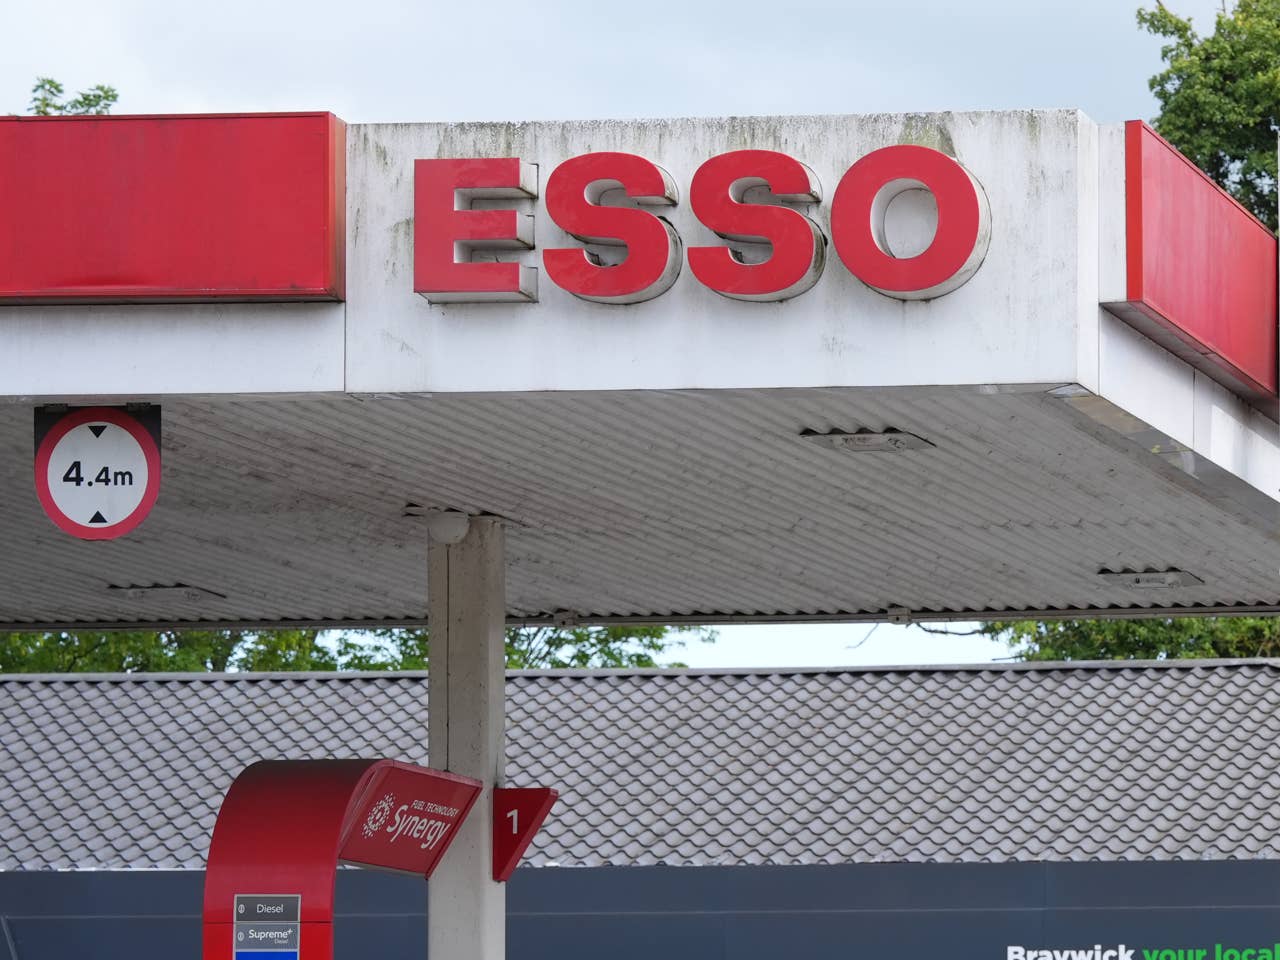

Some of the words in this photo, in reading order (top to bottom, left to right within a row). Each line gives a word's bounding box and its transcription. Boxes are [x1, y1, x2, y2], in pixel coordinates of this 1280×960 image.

[413, 144, 992, 303] ESSO
[62, 460, 134, 487] 4.4m
[412, 800, 425, 810] FUEL
[425, 802, 460, 817] TECHNOLOGY
[506, 809, 519, 834] 1
[387, 805, 451, 850] Synergy
[256, 904, 284, 913] Diesel
